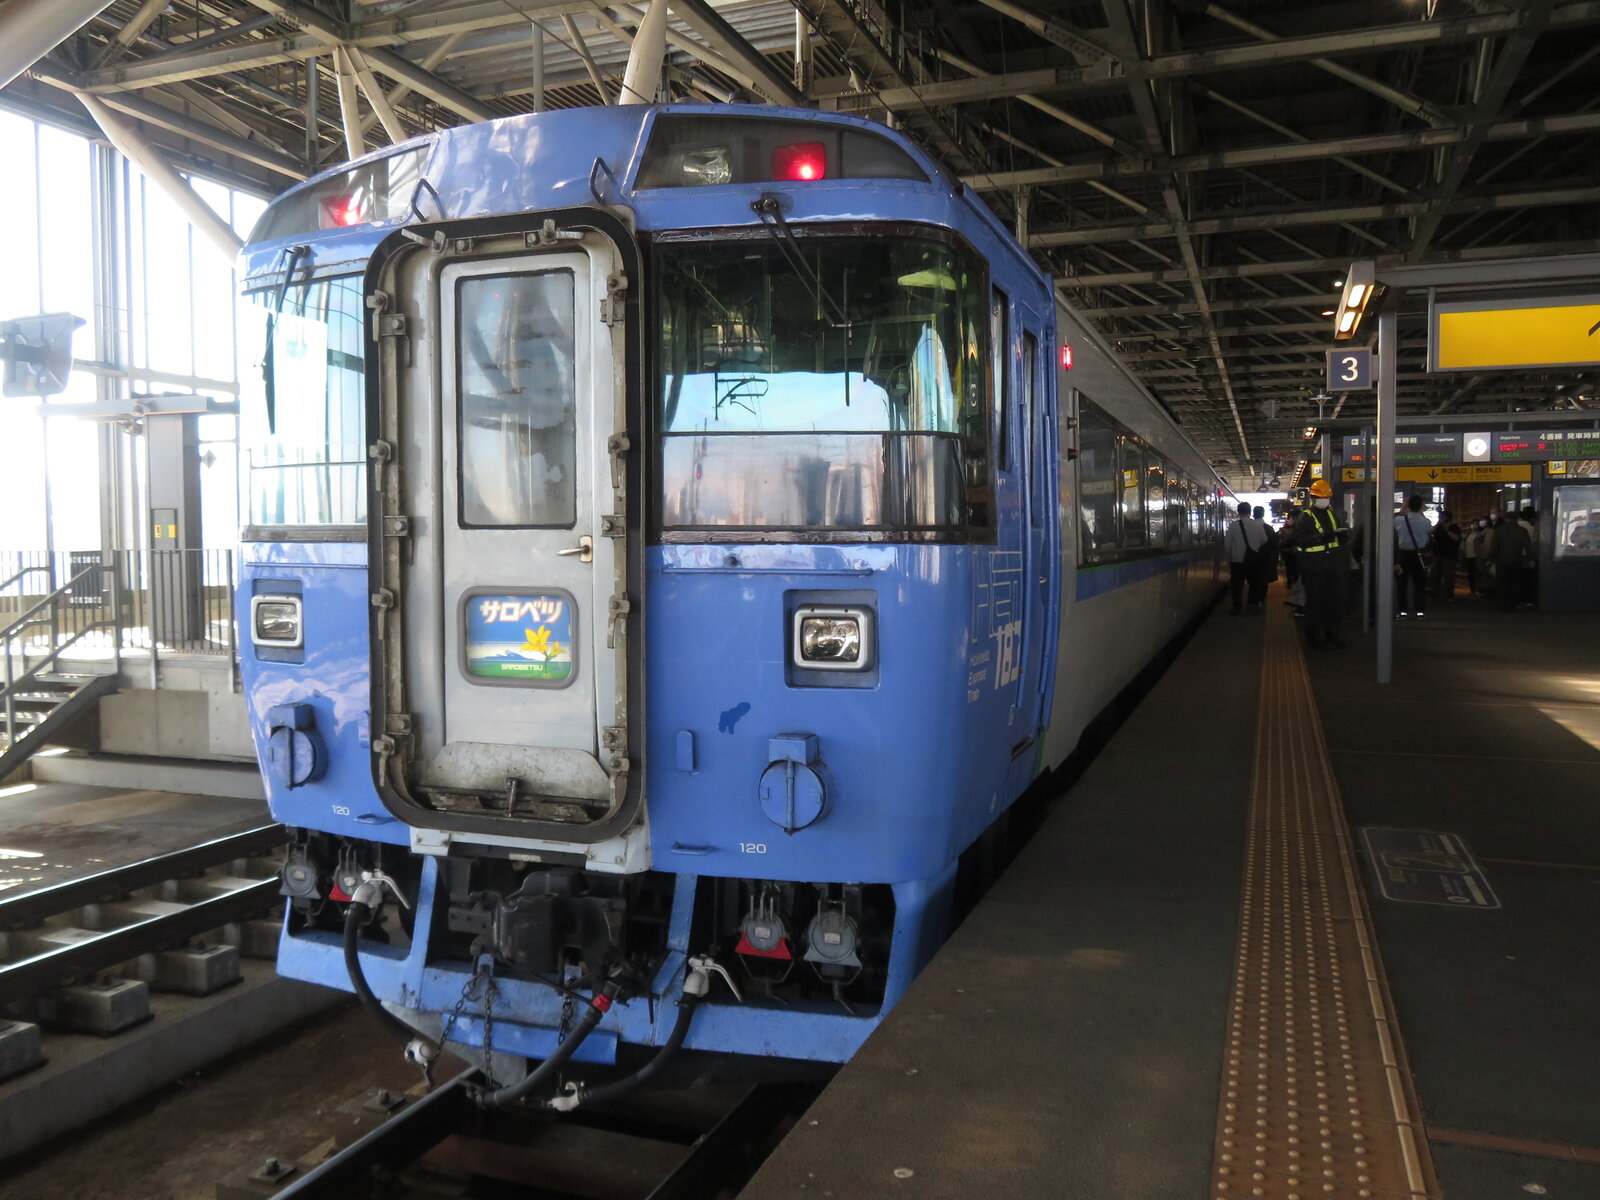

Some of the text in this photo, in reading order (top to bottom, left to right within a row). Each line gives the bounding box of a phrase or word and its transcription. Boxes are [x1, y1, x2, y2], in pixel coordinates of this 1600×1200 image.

[1341, 357, 1358, 382] 3
[480, 600, 562, 623] サロベツ
[332, 805, 350, 816] 120
[740, 843, 767, 854] 120
